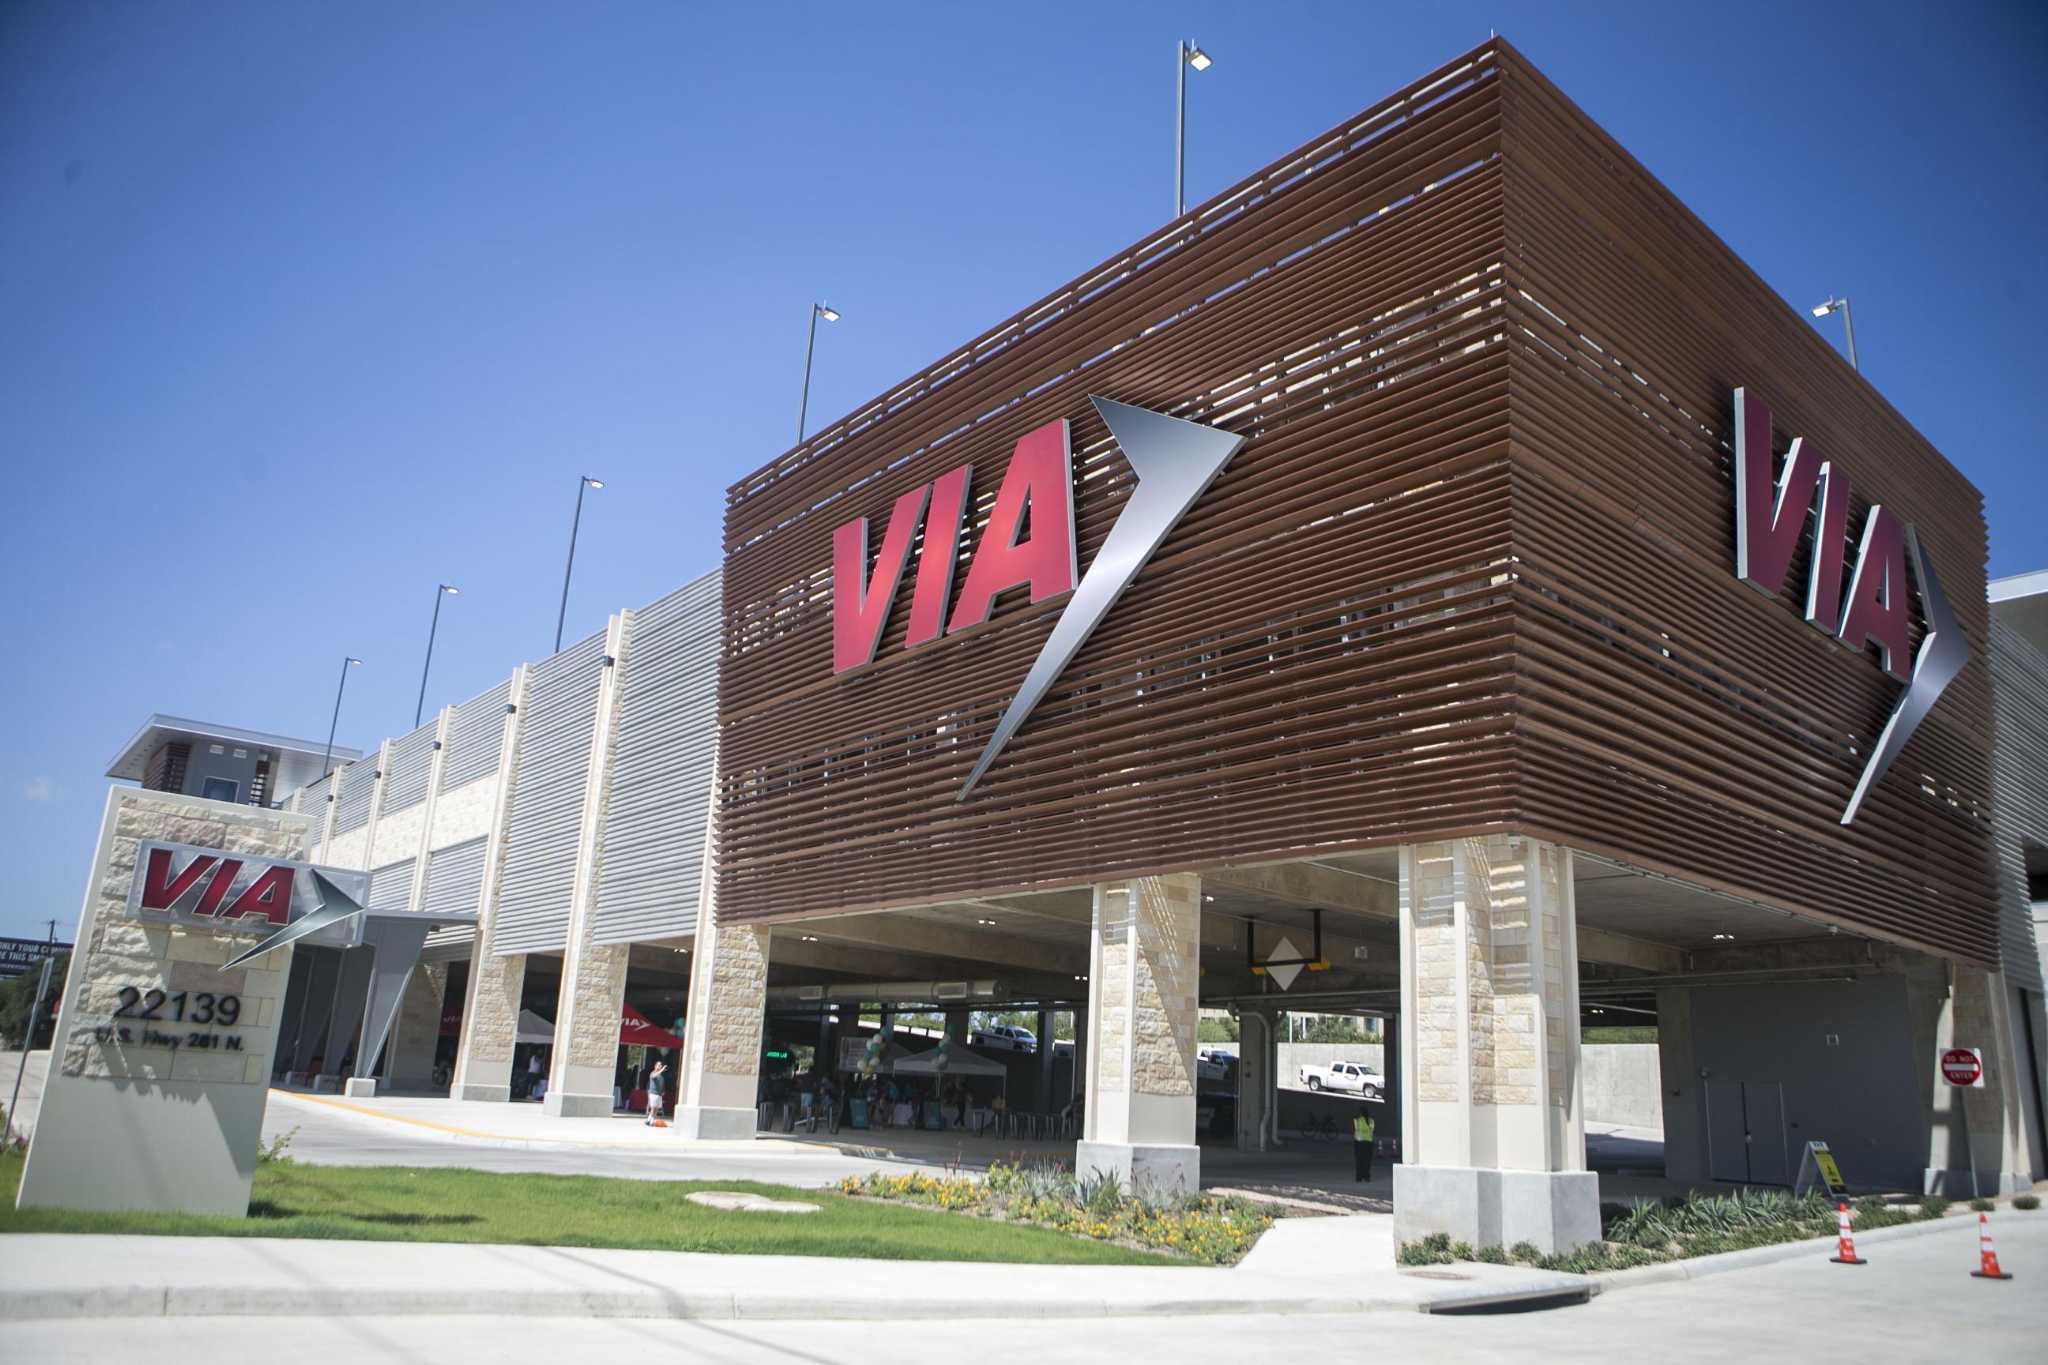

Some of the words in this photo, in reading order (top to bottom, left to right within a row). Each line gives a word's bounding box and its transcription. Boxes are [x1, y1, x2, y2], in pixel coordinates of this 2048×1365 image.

[832, 418, 1078, 675] VIA
[1734, 387, 1911, 685] VIA
[141, 848, 296, 926] VIA
[113, 986, 241, 1026] 22139
[188, 1032, 219, 1049] 281
[1960, 1055, 1974, 1063] NOT
[1951, 1071, 1973, 1079] ENTER
